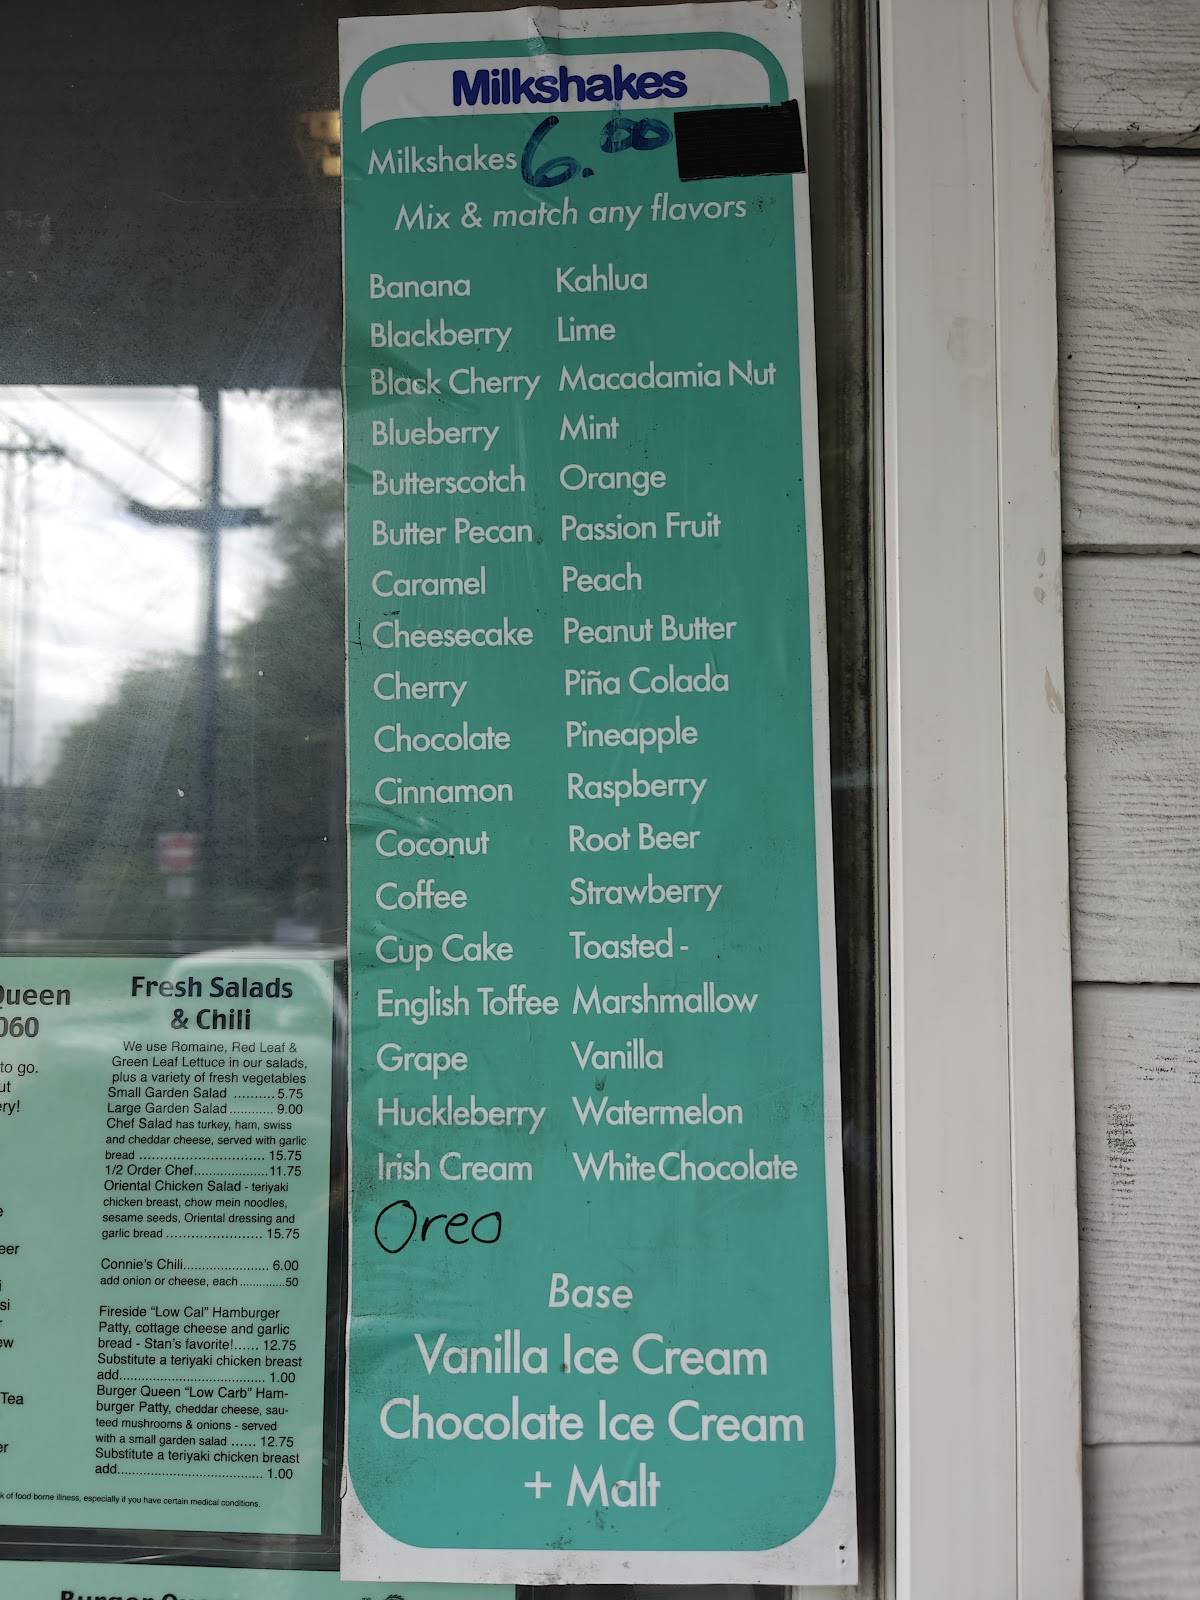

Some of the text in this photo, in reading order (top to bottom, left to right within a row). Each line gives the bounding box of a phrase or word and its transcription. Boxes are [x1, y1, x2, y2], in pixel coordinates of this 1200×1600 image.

[452, 64, 688, 107] Milkshakes
[368, 144, 517, 174] Milkshakes
[395, 192, 746, 231] Mix & match any flavors
[370, 274, 470, 299] Banana
[556, 263, 647, 292] Kahlua
[371, 318, 512, 352] Blackberry
[558, 316, 616, 342] Lime
[371, 366, 541, 400] Black Cherry
[559, 360, 776, 391] Macadamia Nut
[372, 417, 499, 451] Blueberry
[560, 414, 619, 440] Mint
[372, 464, 525, 495] Butterscotch
[560, 464, 666, 496] Orange
[373, 518, 532, 546] Butter Pecan
[562, 512, 721, 541] Passion Fruit
[372, 566, 485, 597] Caramel
[563, 562, 642, 592] Peach
[373, 617, 533, 648] Cheesecake
[564, 615, 737, 644] Peanut Butter
[373, 671, 467, 707] Cherry
[565, 663, 729, 696] Piña Colada
[374, 721, 511, 752] Chocolate
[567, 715, 698, 754] Pineapple
[375, 777, 513, 805] Cinnamon
[568, 768, 707, 807] Raspberry
[376, 829, 489, 857] Coconut
[569, 823, 701, 852] Root Beer
[376, 879, 467, 910] Coffee
[570, 873, 722, 911] Strawberry
[376, 931, 513, 971] Cup Cake
[131, 976, 293, 999] Fresh Salads
[572, 982, 758, 1014] Marshmallow
[171, 1008, 251, 1030] & Chili
[378, 984, 559, 1025] English Toffee
[112, 1056, 225, 1068] Green Leaf Lettuce
[232, 1042, 255, 1053] Red
[260, 1042, 285, 1053] Leaf
[377, 1043, 468, 1080] Grape
[571, 1038, 663, 1070] Vanilla
[0, 1062, 13, 1073] to
[242, 1072, 306, 1086] vegetables
[108, 1086, 303, 1099] Small Garden Salad 5.75
[106, 1117, 292, 1130] Chef Salad swiss
[107, 1102, 303, 1116] Large Garden Salad 9.00
[378, 1095, 546, 1134] Huckleberry
[572, 1093, 743, 1126] Watermelon
[105, 1150, 302, 1161] bread 15.75
[128, 1134, 171, 1144] cheddar
[217, 1136, 252, 1145] served
[279, 1136, 307, 1148] garlic
[105, 1164, 302, 1177] 1/2 Order 11.75
[379, 1150, 532, 1181] Irish Cream
[104, 1179, 289, 1194] Oriental Chicken Salad teriyaki
[103, 1196, 143, 1207] chicken
[102, 1214, 144, 1223] sesame
[184, 1212, 225, 1223] Oriental
[228, 1213, 272, 1226] dressing
[374, 1200, 502, 1254] Oreo
[101, 1228, 300, 1240] garlic bread 15.75
[272, 1260, 299, 1271] 6.00
[122, 1277, 151, 1286] onion
[212, 1277, 238, 1286] each
[549, 1273, 633, 1308] Base
[99, 1305, 147, 1317] Fireside
[212, 1306, 280, 1321] Hamburger
[98, 1337, 132, 1349] bread
[264, 1339, 297, 1351] 12.75
[135, 1322, 180, 1336] cottage
[183, 1322, 227, 1334] cheese
[257, 1323, 290, 1337] garlic
[97, 1352, 302, 1368] Substitute teriyaki chicken breast
[414, 1329, 767, 1375] Vanilla Ice Cream
[0, 1392, 24, 1405] Tea
[97, 1384, 288, 1399] Burger Queen Ham-
[96, 1400, 135, 1415] burger
[175, 1404, 218, 1414] cheddar
[380, 1395, 804, 1442] Chocolate Ice Cream
[121, 1418, 277, 1431] mushrooms onions served
[129, 1434, 294, 1448] small garden salad 12.75
[524, 1462, 661, 1507] + Malt
